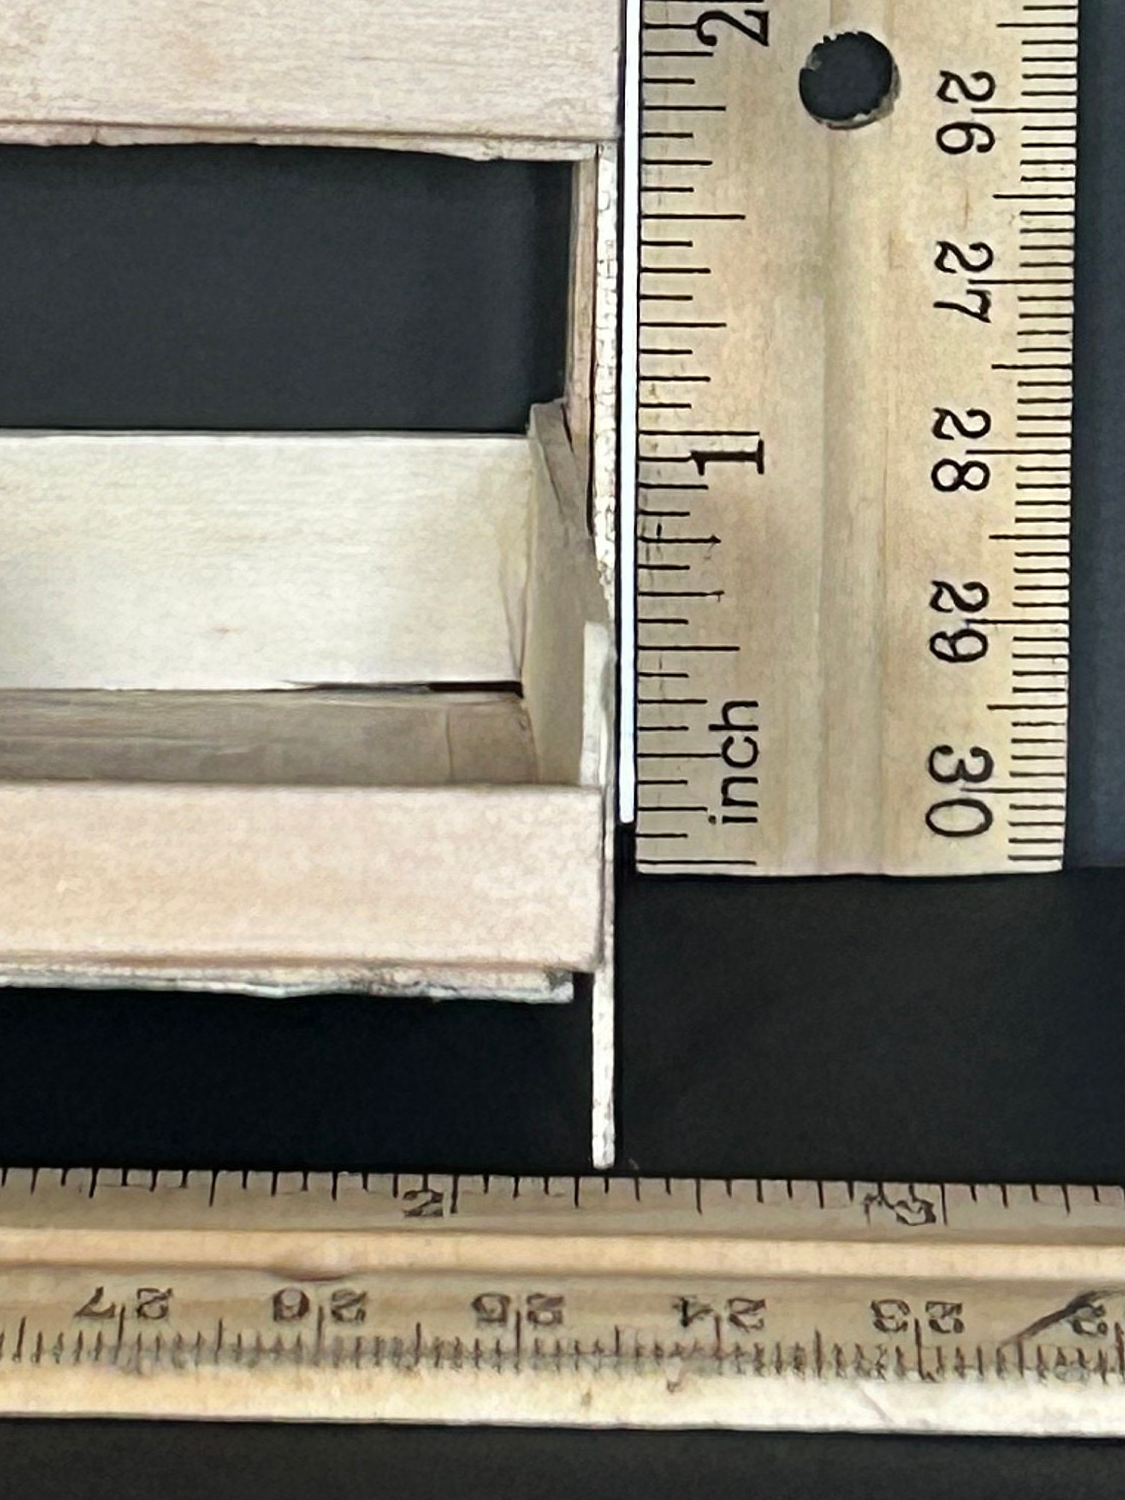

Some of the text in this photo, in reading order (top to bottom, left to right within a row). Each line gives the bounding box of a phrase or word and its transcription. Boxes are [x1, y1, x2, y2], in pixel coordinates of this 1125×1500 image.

[695, 8, 770, 48] 2
[935, 70, 997, 156] 26
[933, 240, 994, 325] 27
[690, 438, 765, 475] 1
[930, 407, 992, 493] 28
[928, 580, 990, 664] 29
[707, 700, 760, 825] inch
[924, 743, 995, 838] 30
[75, 1285, 174, 1321] 27
